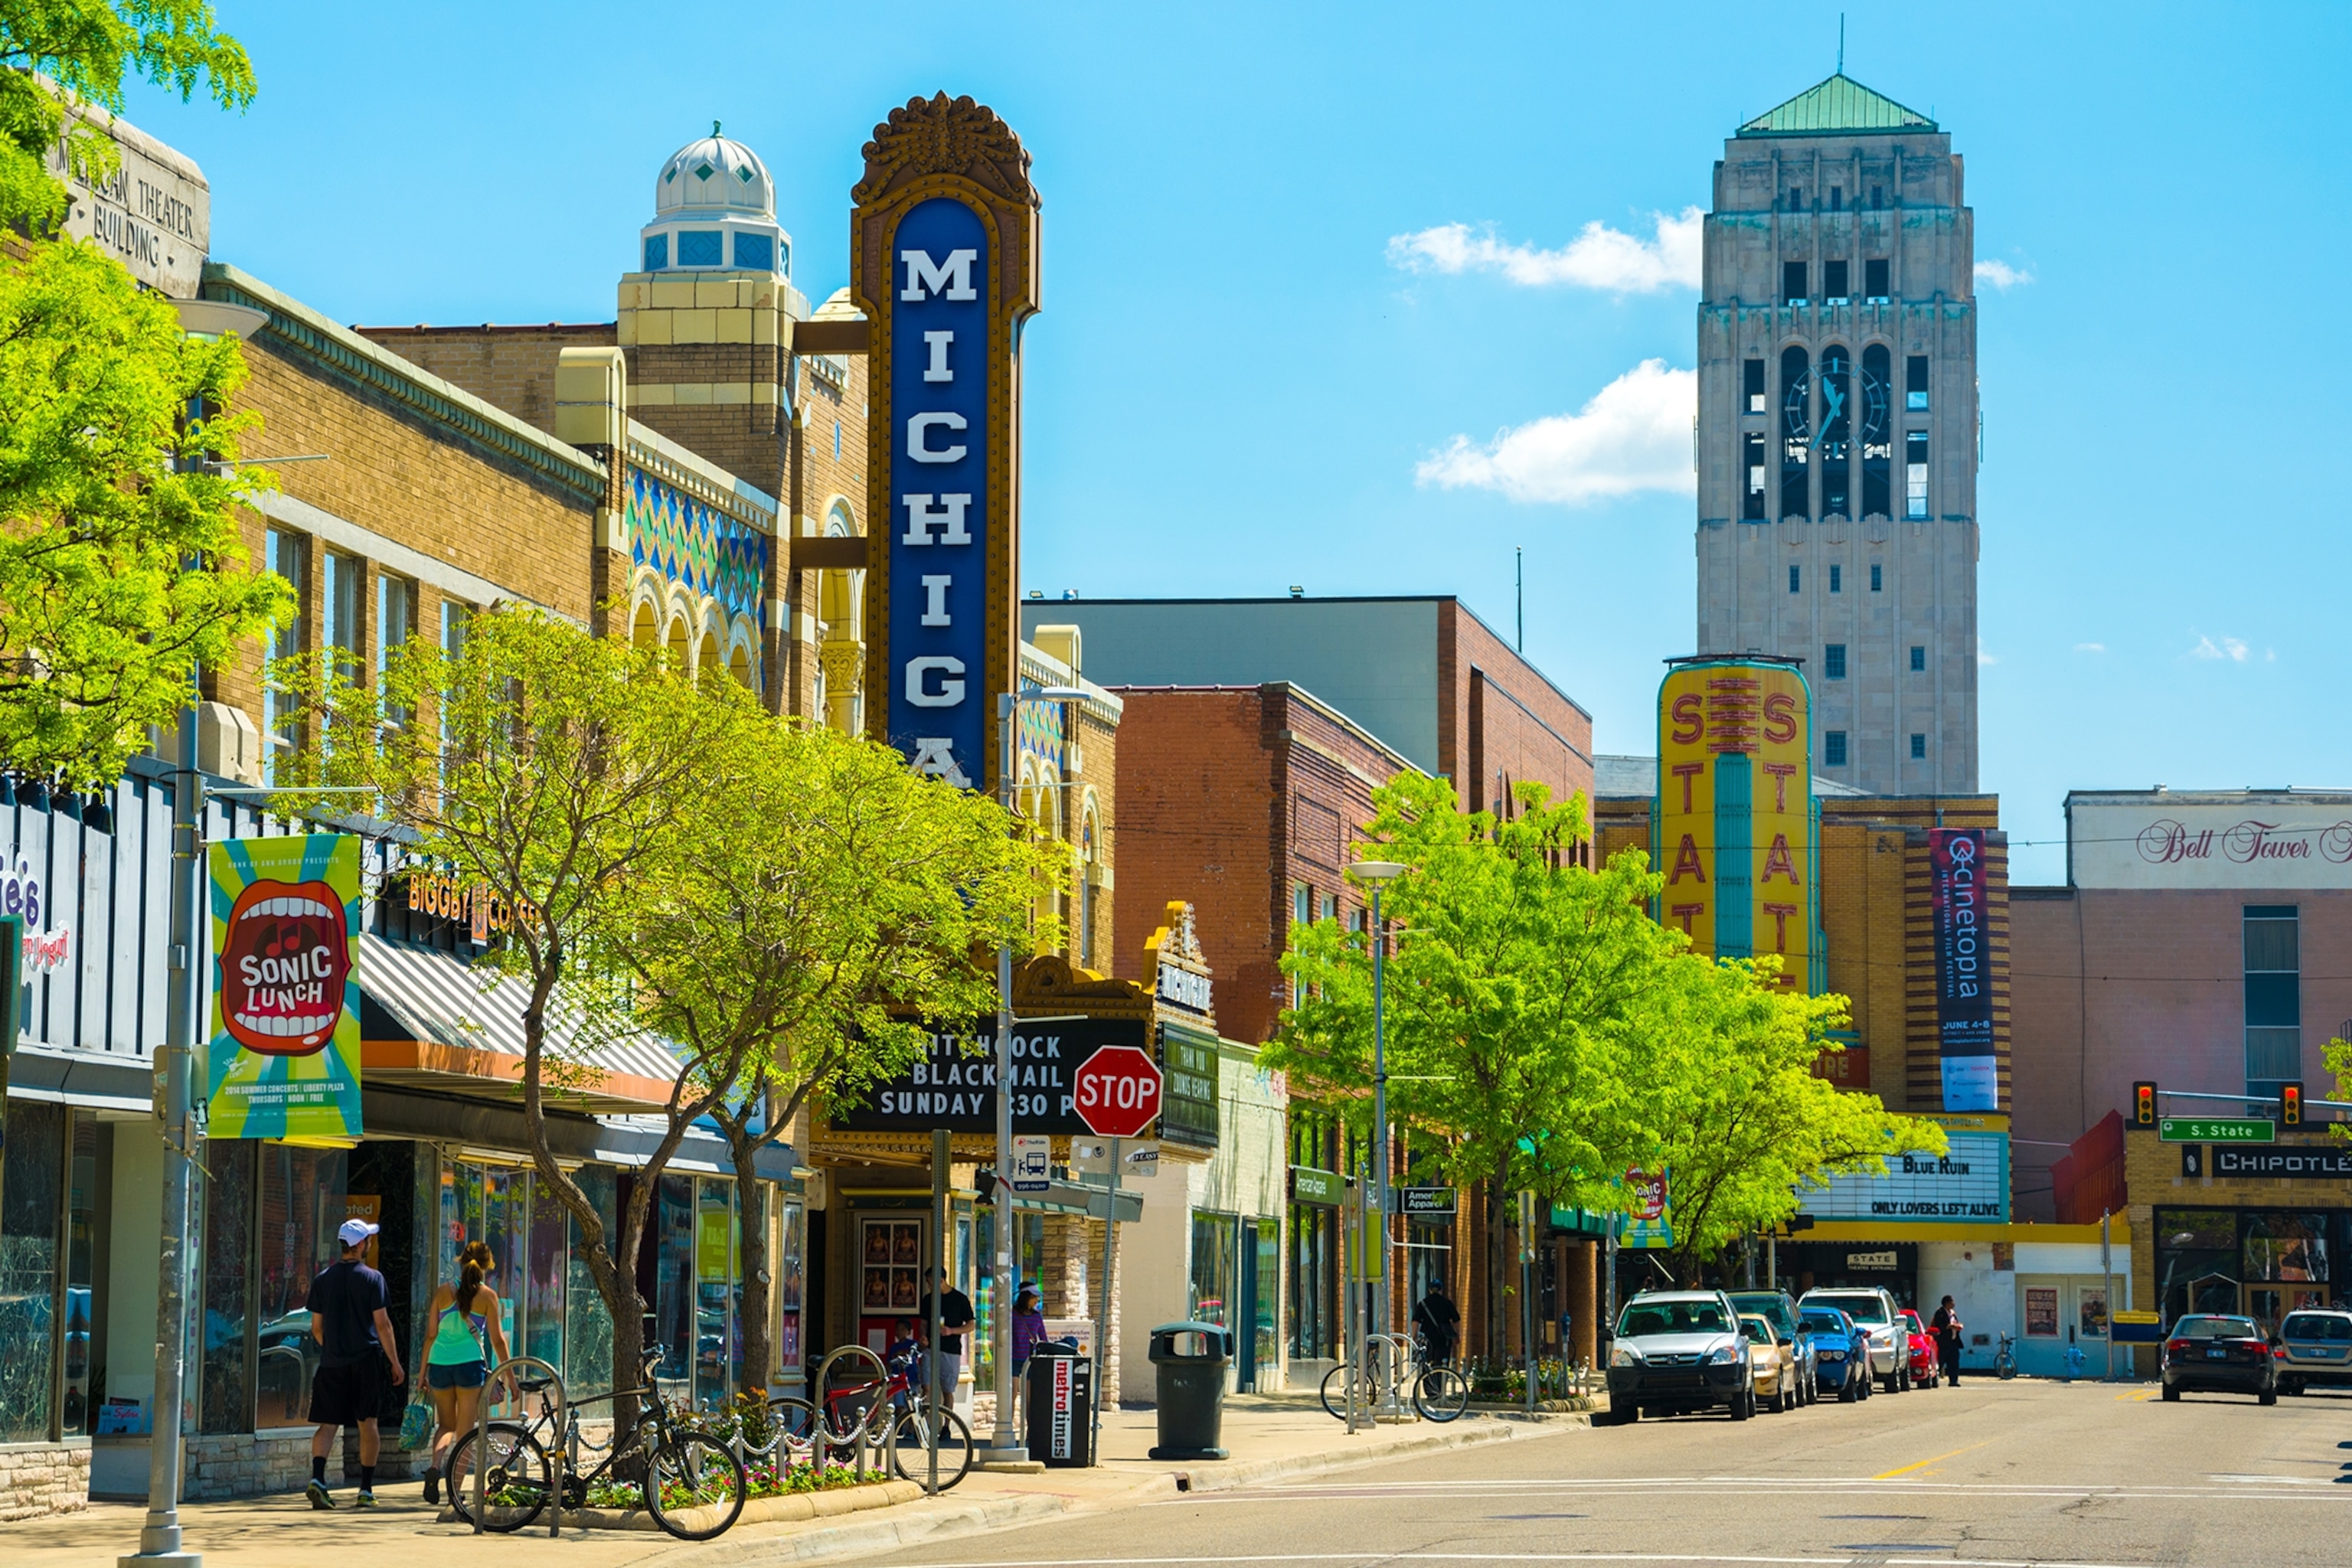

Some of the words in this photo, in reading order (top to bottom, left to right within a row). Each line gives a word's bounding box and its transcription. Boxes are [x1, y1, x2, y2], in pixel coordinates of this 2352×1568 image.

[138, 178, 193, 239] THEATER
[94, 203, 160, 266] BUILDING
[900, 249, 977, 788] MICHIGA
[1761, 693, 1799, 988] STAT
[2136, 818, 2214, 863] Bell
[2222, 820, 2311, 863] Tower
[1942, 870, 1952, 934] INTERNATIONAL
[1954, 868, 1979, 998] cinetopia
[240, 945, 332, 987] SONIC
[1946, 961, 1955, 998] FESTIVAL
[247, 982, 323, 1013] LUNCH
[1943, 1021, 1969, 1030] JUNE
[1971, 1020, 1991, 1028] 4-8
[914, 1034, 1061, 1058] ITHOCK
[225, 1086, 240, 1095] 2014
[240, 1086, 267, 1094] SUMMER
[268, 1084, 299, 1093] CONCERTS
[303, 1083, 327, 1093] LIBERTY
[327, 1083, 345, 1092] PLAZA
[248, 1095, 283, 1104] THURSDAYS
[288, 1094, 305, 1102] NOON
[309, 1093, 324, 1102] FREE
[880, 1091, 985, 1116] SUNDAY
[1060, 1095, 1074, 1116] P
[1080, 1073, 1156, 1109] STOP
[2190, 1125, 2204, 1136] S.
[2210, 1125, 2253, 1137] State
[1635, 1182, 1661, 1196] ONIC
[1872, 1201, 1898, 1214] ONLY
[1900, 1202, 1940, 1215] LOVERS
[1942, 1203, 1968, 1215] LEFT
[1969, 1204, 2000, 1216] ALIVE
[1054, 1361, 1070, 1458] metrotimes
